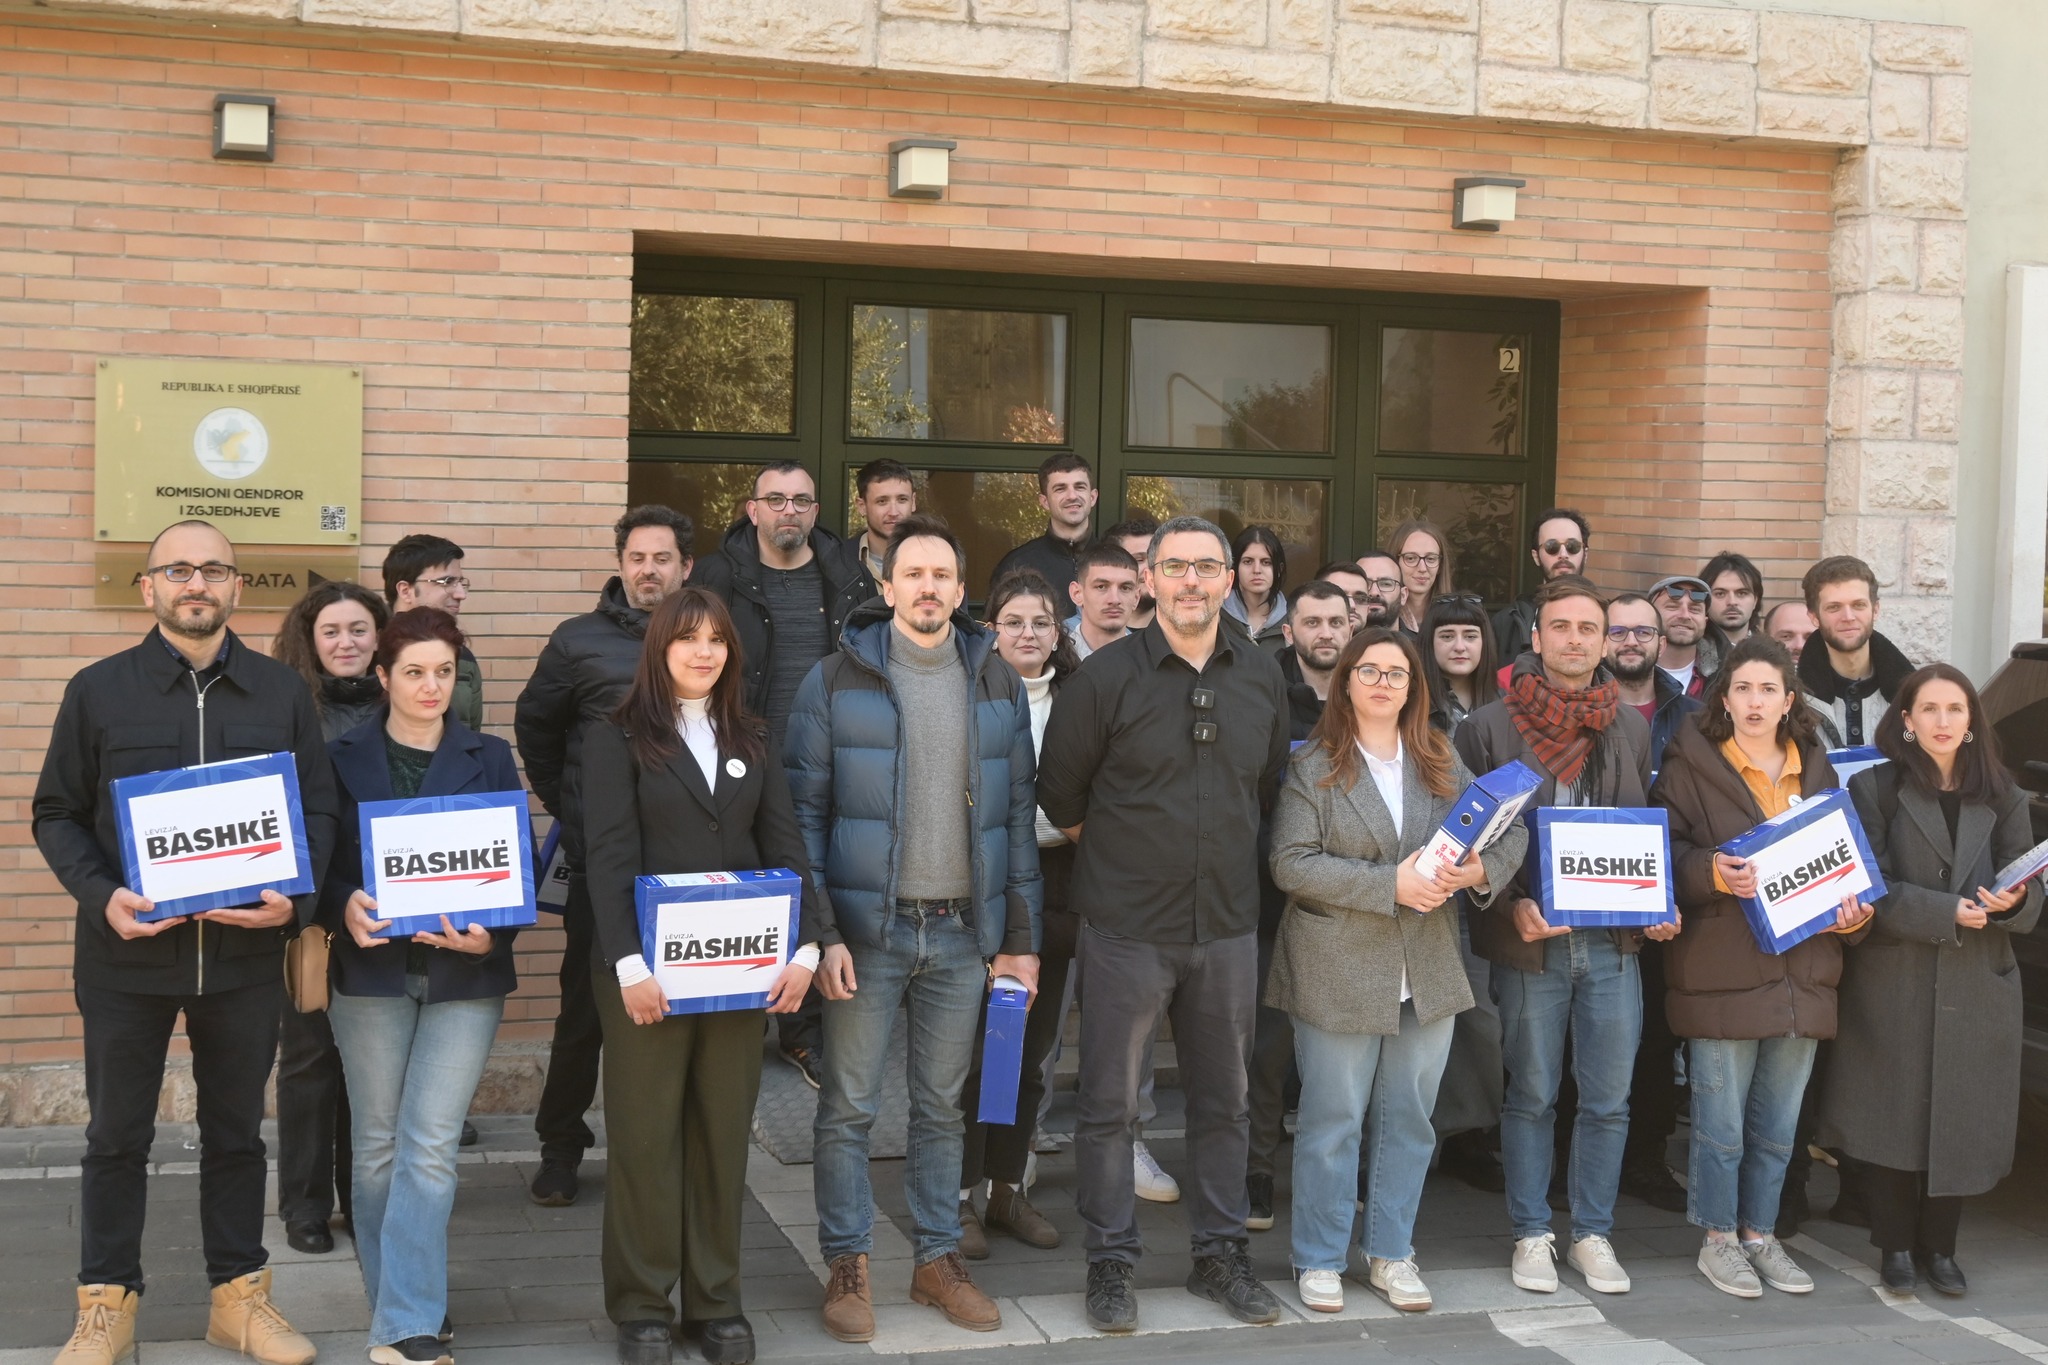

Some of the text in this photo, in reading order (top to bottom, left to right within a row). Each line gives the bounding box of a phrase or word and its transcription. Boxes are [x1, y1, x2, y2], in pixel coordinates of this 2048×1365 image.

[1503, 350, 1514, 370] 2
[161, 381, 302, 396] REPUBLIKA E SHQIPËRISË
[156, 486, 304, 501] KOMISIONI QENDROR
[179, 505, 281, 518] I ZGJEDHJEVE
[146, 809, 281, 860] BASHKË
[384, 839, 510, 878] BASHKË
[1560, 852, 1657, 877] BASHKË
[1763, 838, 1853, 903] BASHKË
[664, 926, 779, 962] BASHKË
